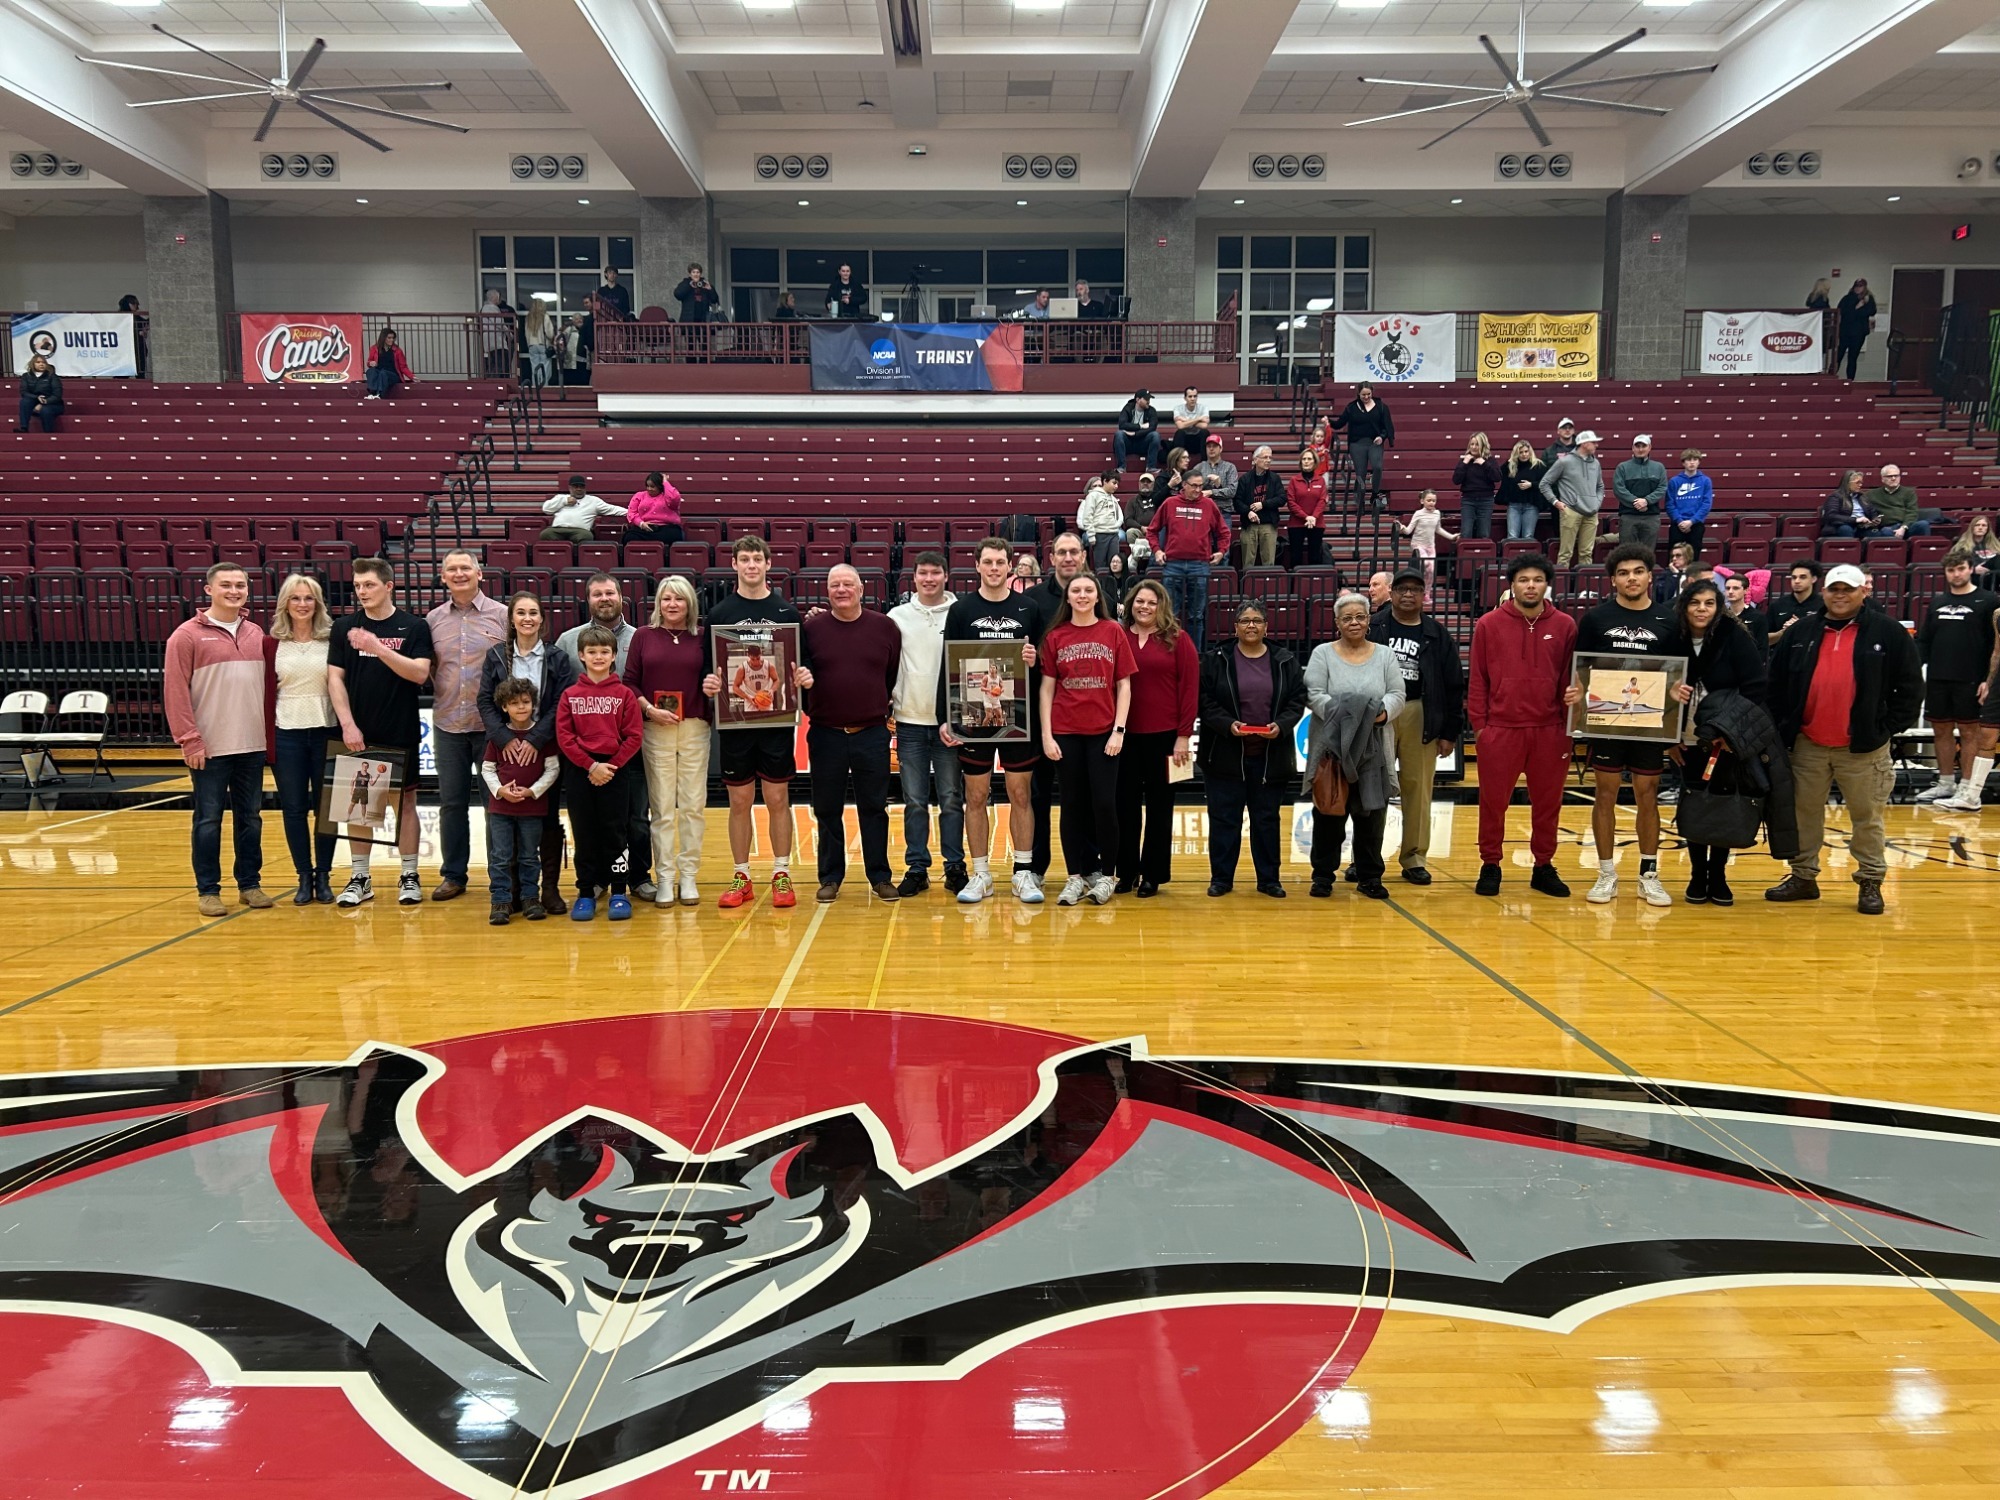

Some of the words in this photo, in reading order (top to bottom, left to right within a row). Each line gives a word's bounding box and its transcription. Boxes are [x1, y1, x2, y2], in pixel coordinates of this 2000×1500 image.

[1367, 318, 1421, 337] GUS'S
[1484, 322, 1537, 337] WHICH
[1719, 328, 1744, 336] KEEP
[63, 331, 118, 348] UNITED
[292, 328, 323, 340] Raising
[1716, 338, 1744, 346] CALM
[1767, 335, 1808, 346] NOODLES
[76, 350, 88, 358] AS
[90, 350, 109, 358] ONE
[262, 325, 349, 381] Cane's
[872, 350, 896, 360] NCAA
[915, 350, 975, 364] TRANSY
[1708, 353, 1753, 362] NOODLE
[866, 366, 894, 375] Division
[1364, 352, 1392, 382] WORLD
[1395, 351, 1424, 382] FAMOUS
[1721, 363, 1737, 371] ON
[1496, 371, 1518, 379] South
[1519, 371, 1557, 379] Limestone
[1557, 371, 1577, 379] Suite
[979, 631, 1015, 639] BASKETBALL
[1612, 641, 1648, 651] BASKETBALL
[18, 693, 33, 709] T
[78, 693, 93, 709] T
[568, 696, 623, 715] TRANSY
[694, 1468, 771, 1491] TM
